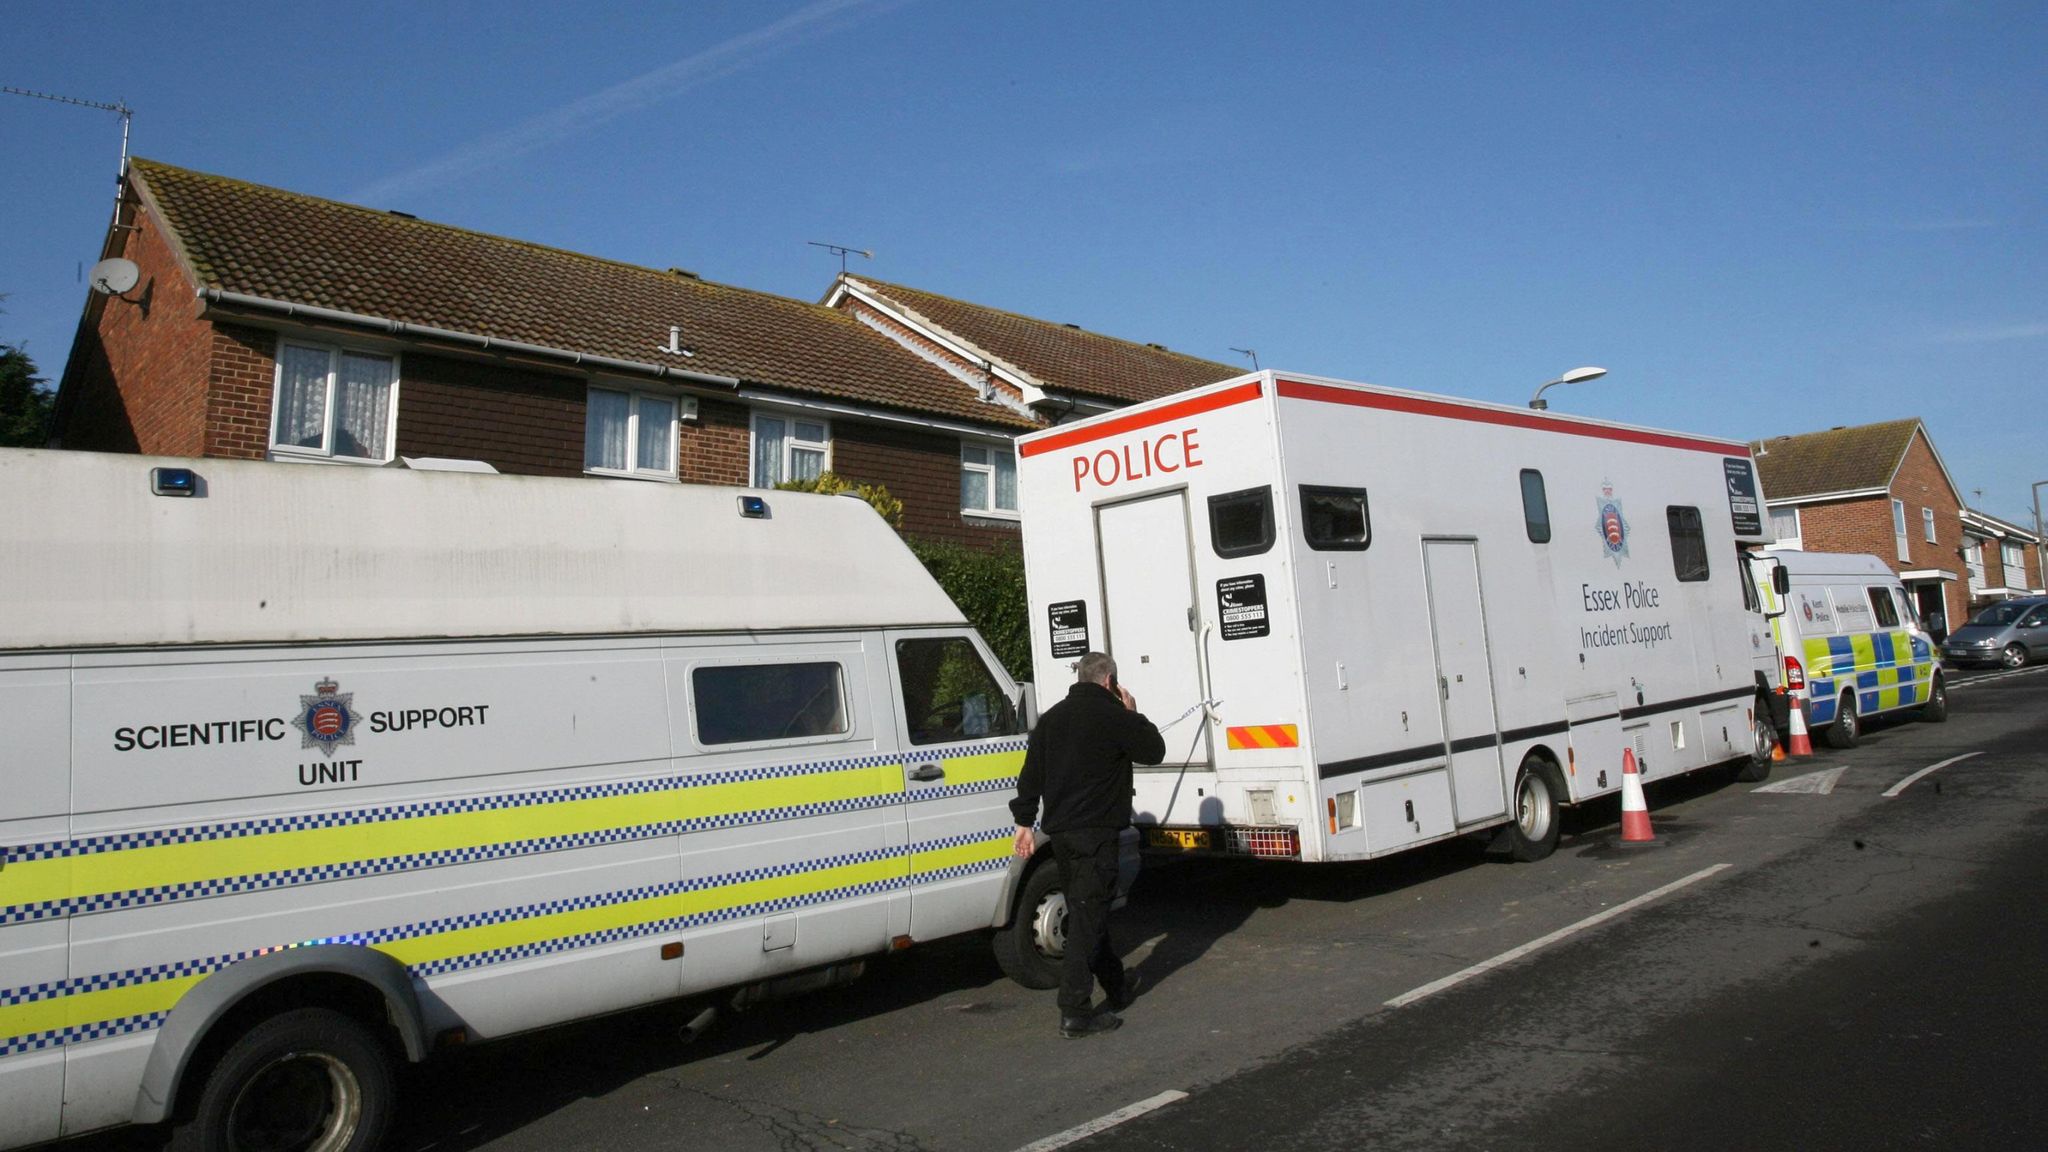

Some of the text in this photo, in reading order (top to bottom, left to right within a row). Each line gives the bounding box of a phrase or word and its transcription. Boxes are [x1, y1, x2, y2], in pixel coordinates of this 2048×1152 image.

[1073, 428, 1203, 493] POLICE
[1222, 604, 1264, 615] CRIMESTOPPERS
[1582, 581, 1659, 611] Essex Police
[1226, 614, 1239, 622] 0800
[1581, 621, 1672, 649] Incident Support
[114, 705, 489, 752] SCIENTIFIC SUPPORT
[299, 760, 363, 786] UNIT
